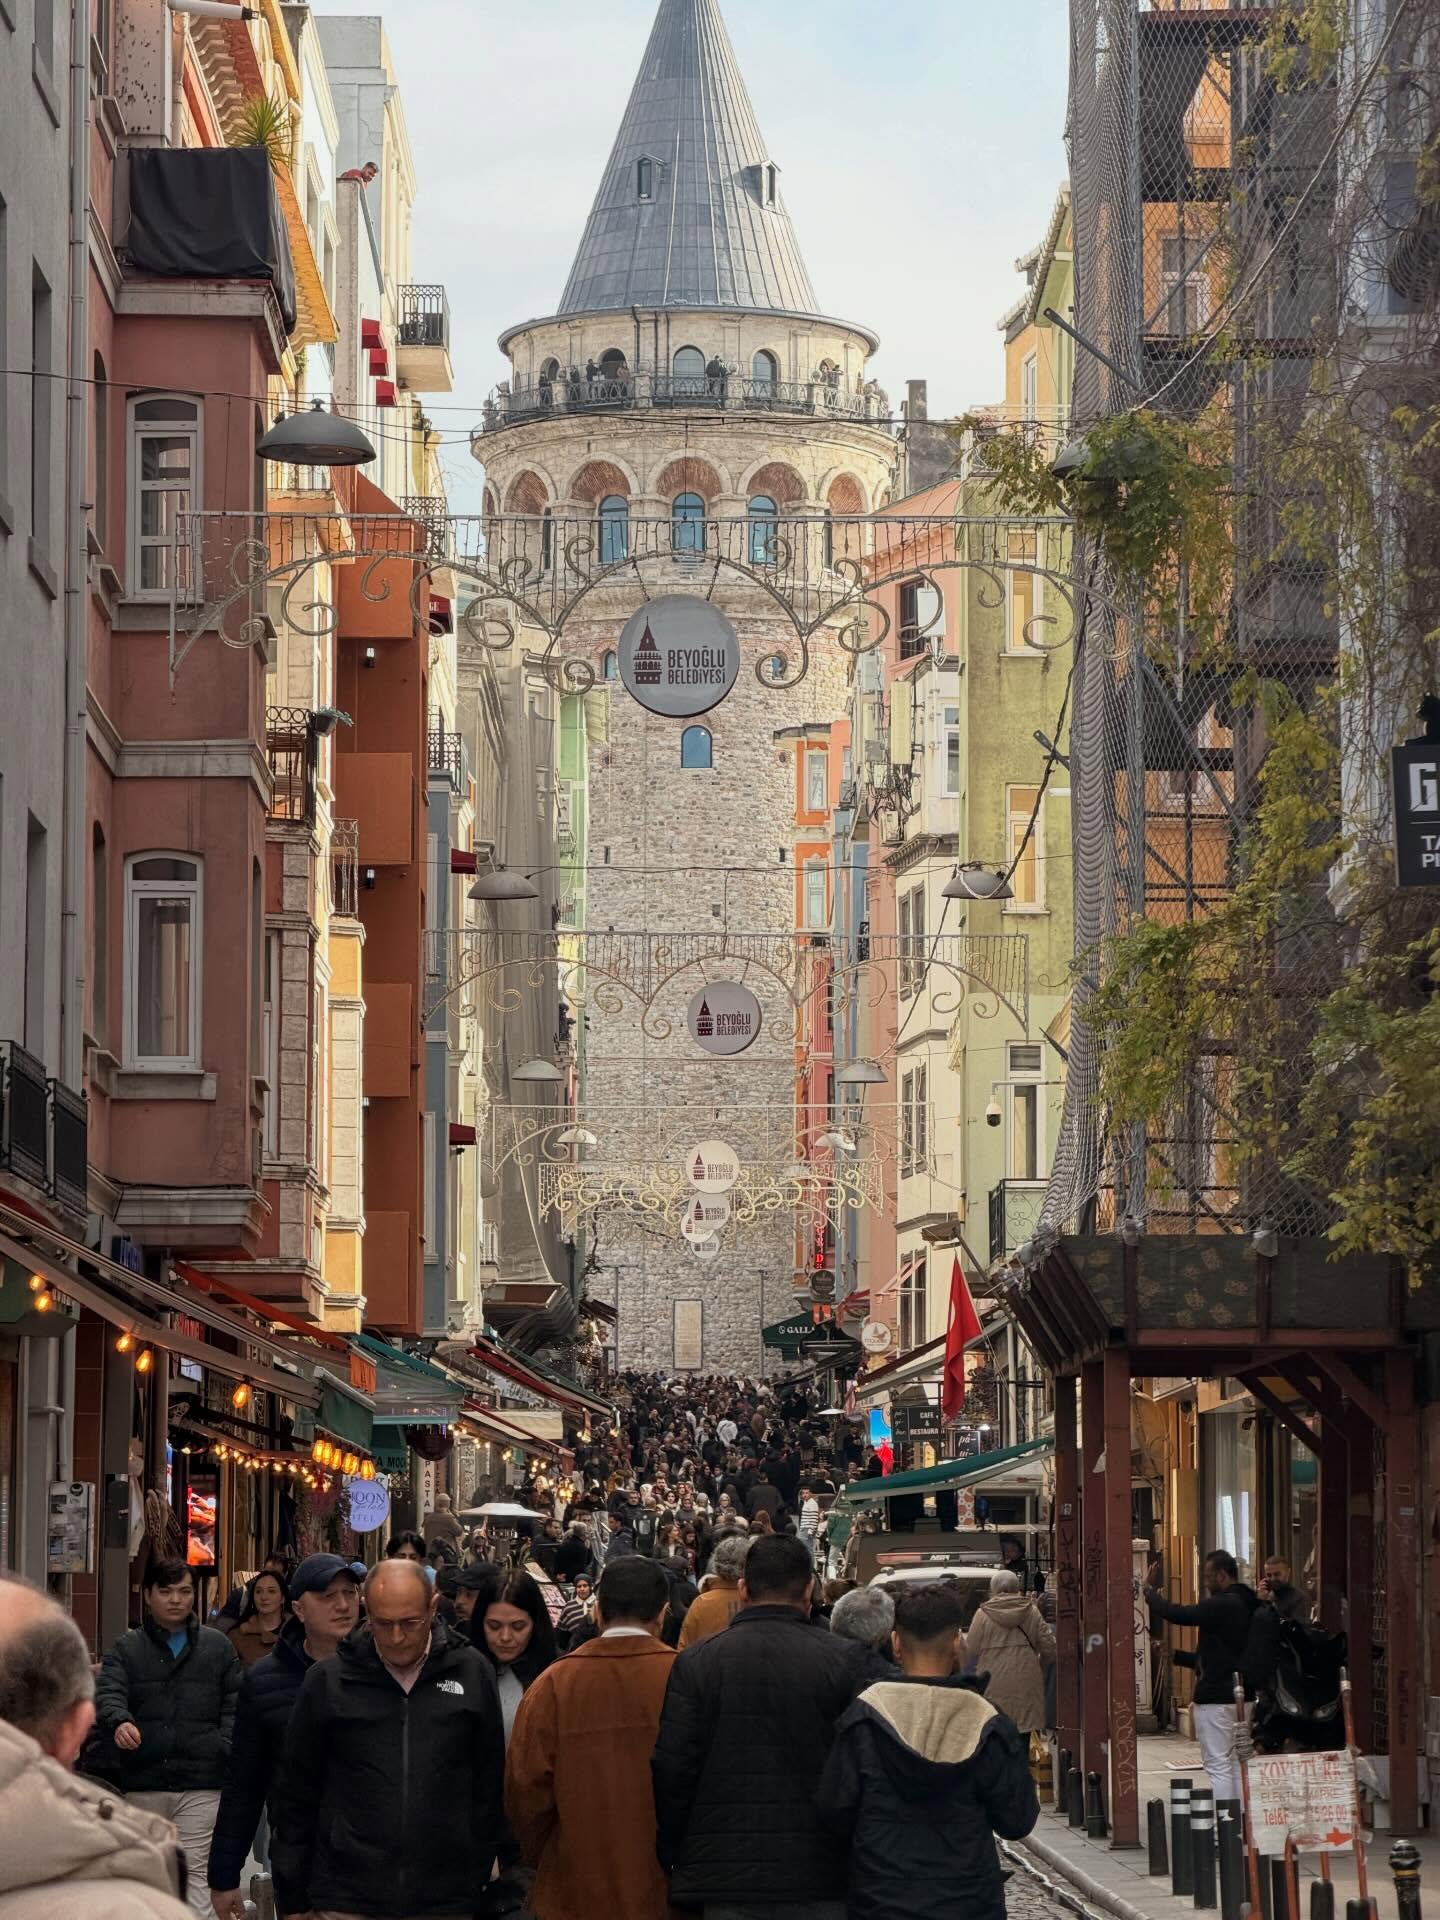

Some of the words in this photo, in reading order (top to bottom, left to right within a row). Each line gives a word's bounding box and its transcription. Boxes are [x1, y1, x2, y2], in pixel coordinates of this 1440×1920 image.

[668, 645, 725, 668] BEYOĞLU
[668, 669, 726, 685] BELEDİYESİ
[716, 1011, 751, 1026] BEYOĞLU
[716, 1025, 751, 1036] BELEDİYESİ
[919, 1411, 935, 1419] CAFE
